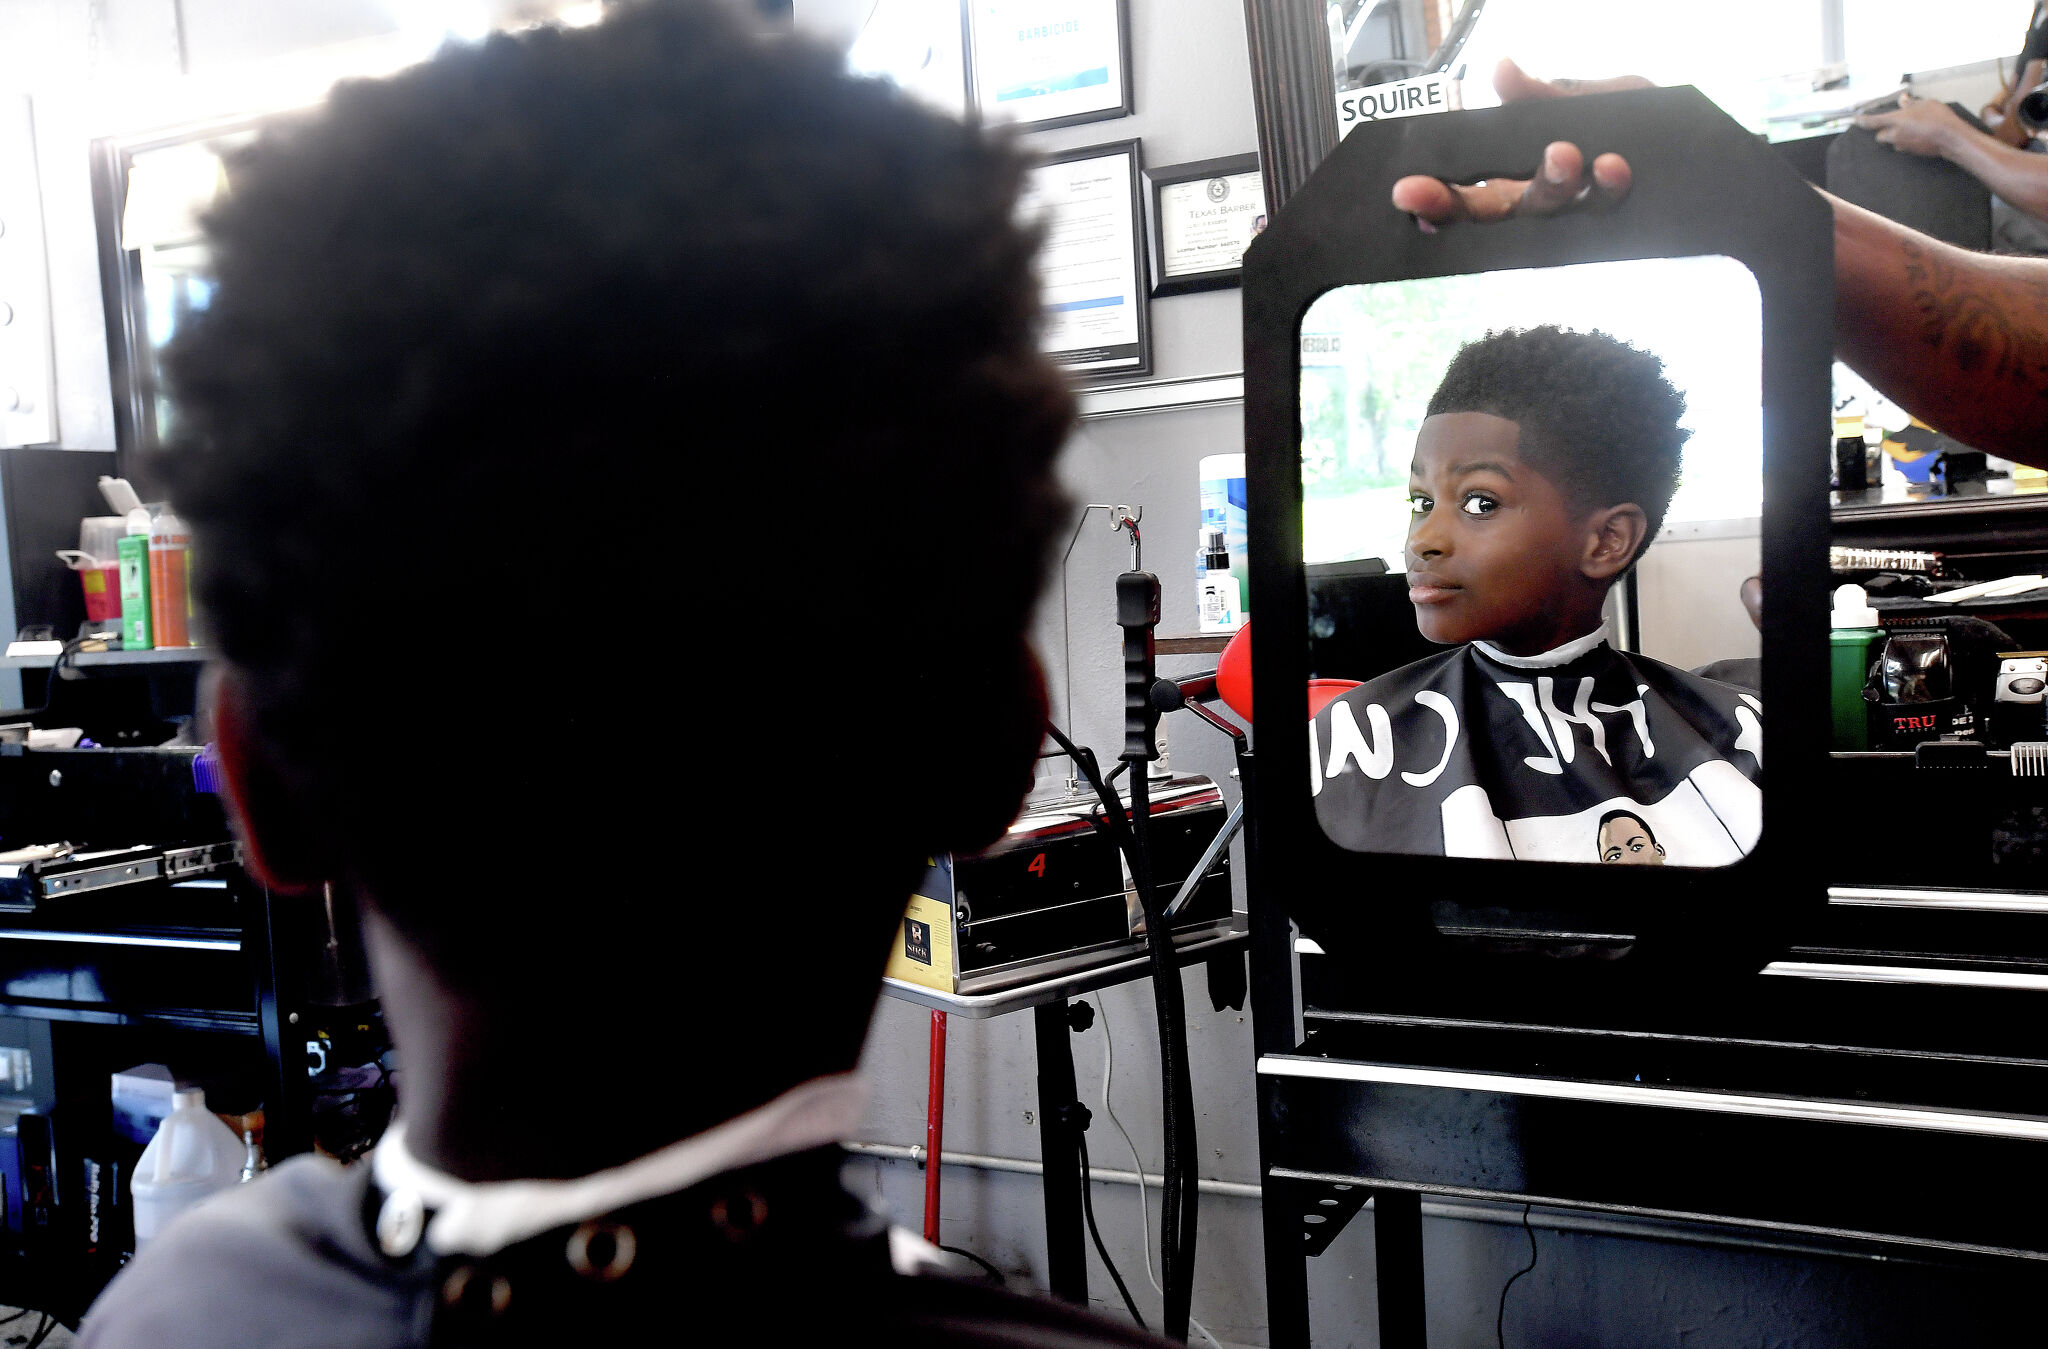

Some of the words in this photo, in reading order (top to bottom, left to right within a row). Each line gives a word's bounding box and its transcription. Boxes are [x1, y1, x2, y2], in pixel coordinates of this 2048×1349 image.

[1018, 20, 1079, 42] BARBICIDE
[1220, 203, 1256, 215] BARBER
[1893, 715, 1936, 729] TRU
[1028, 853, 1046, 878] 4
